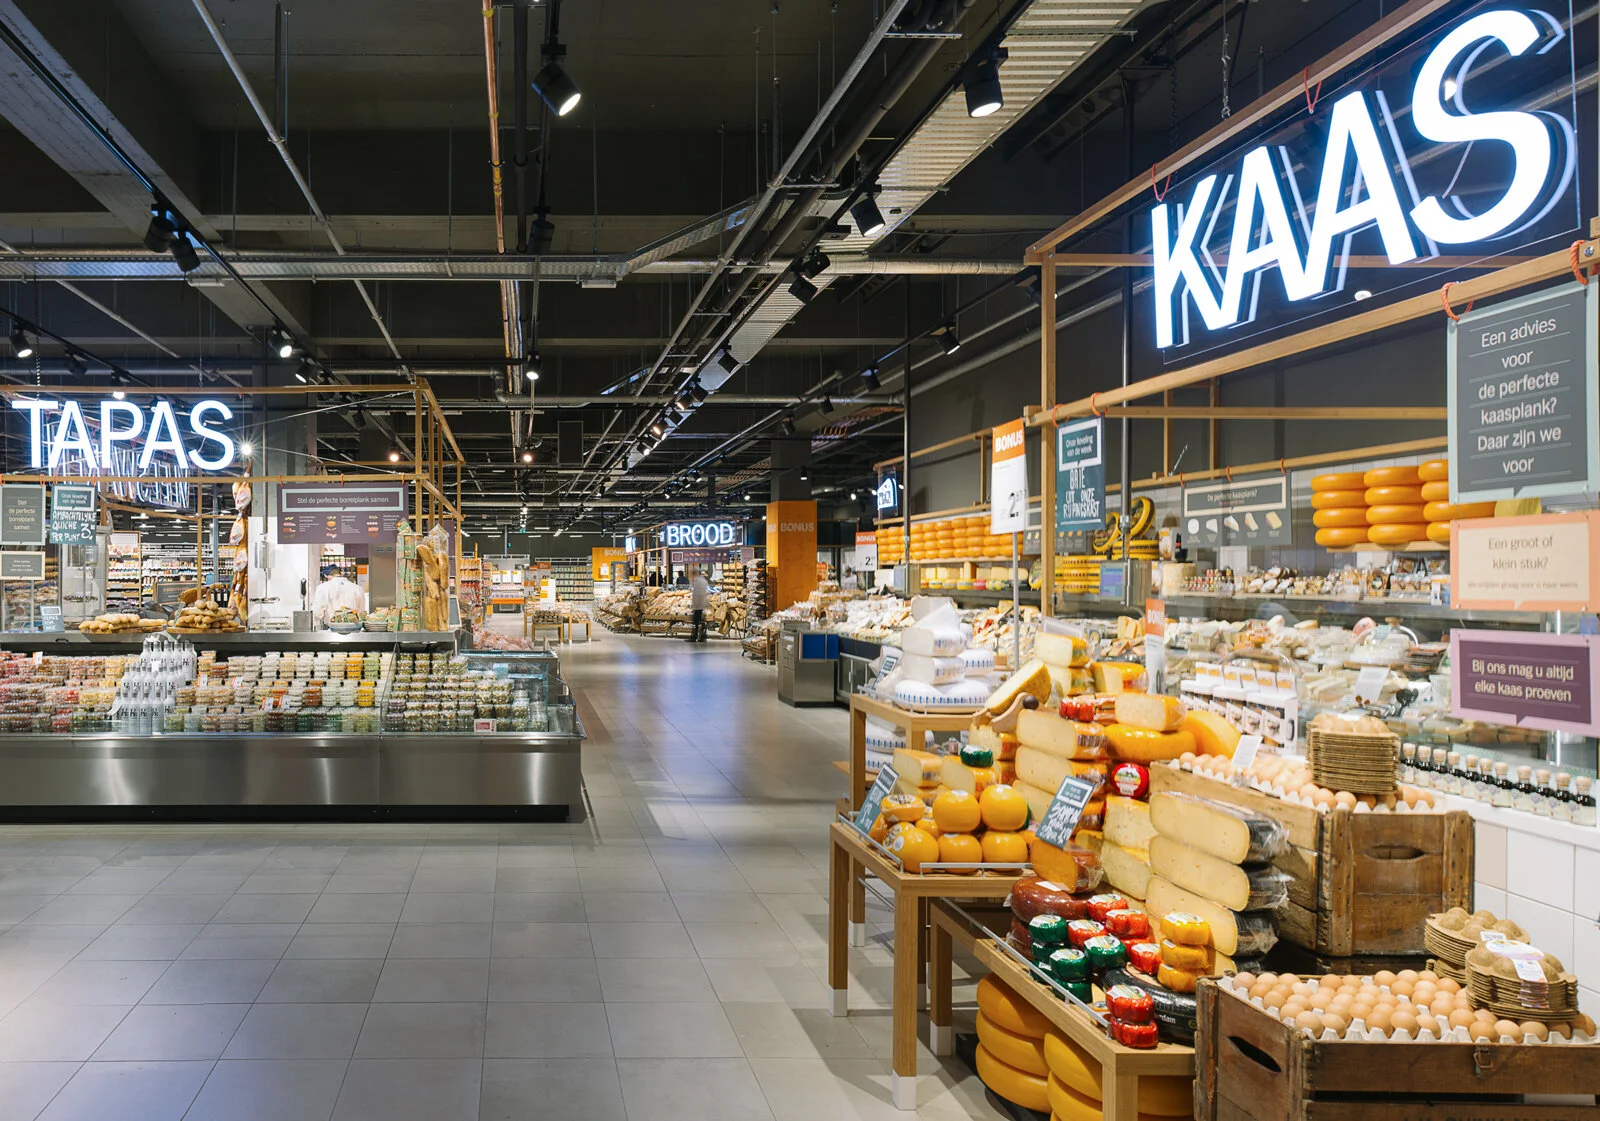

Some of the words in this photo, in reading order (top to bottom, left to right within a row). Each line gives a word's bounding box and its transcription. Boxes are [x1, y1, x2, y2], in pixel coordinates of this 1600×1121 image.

[1152, 10, 1553, 348] KAAS
[1481, 330, 1506, 348] Een
[1510, 318, 1557, 341] advies
[1501, 350, 1534, 369] voor
[1478, 382, 1495, 400] de
[1499, 371, 1560, 398] perfecte
[1481, 396, 1557, 425] kaasplank?
[12, 400, 235, 470] TAPAS
[995, 430, 1023, 452] BONUS
[1065, 440, 1076, 449] Onze
[1477, 434, 1509, 452] Daar
[1512, 429, 1536, 447] zijn
[1540, 426, 1562, 441] we
[1502, 457, 1535, 474] voor
[1070, 467, 1086, 490] BRIE
[1066, 490, 1075, 504] UIT
[1081, 487, 1095, 503] ONZE
[16, 508, 36, 516] perfecte
[51, 532, 63, 541] PER
[64, 532, 80, 541] PUNT
[52, 520, 77, 531] QUICHE
[667, 523, 733, 546] BROOD
[780, 522, 815, 532] BONUS
[1488, 537, 1508, 550] Een
[1510, 536, 1539, 551] groot
[1542, 535, 1553, 548] of
[1492, 557, 1517, 570] klein
[1520, 557, 1549, 570] stuk?
[1472, 658, 1485, 674] Bij
[1486, 662, 1506, 675] ons
[1508, 662, 1534, 680] mag
[1535, 666, 1543, 678] u
[1546, 664, 1574, 683] altijd
[1474, 679, 1496, 694] elke
[1497, 680, 1523, 697] kaas
[1525, 685, 1572, 702] proeven
